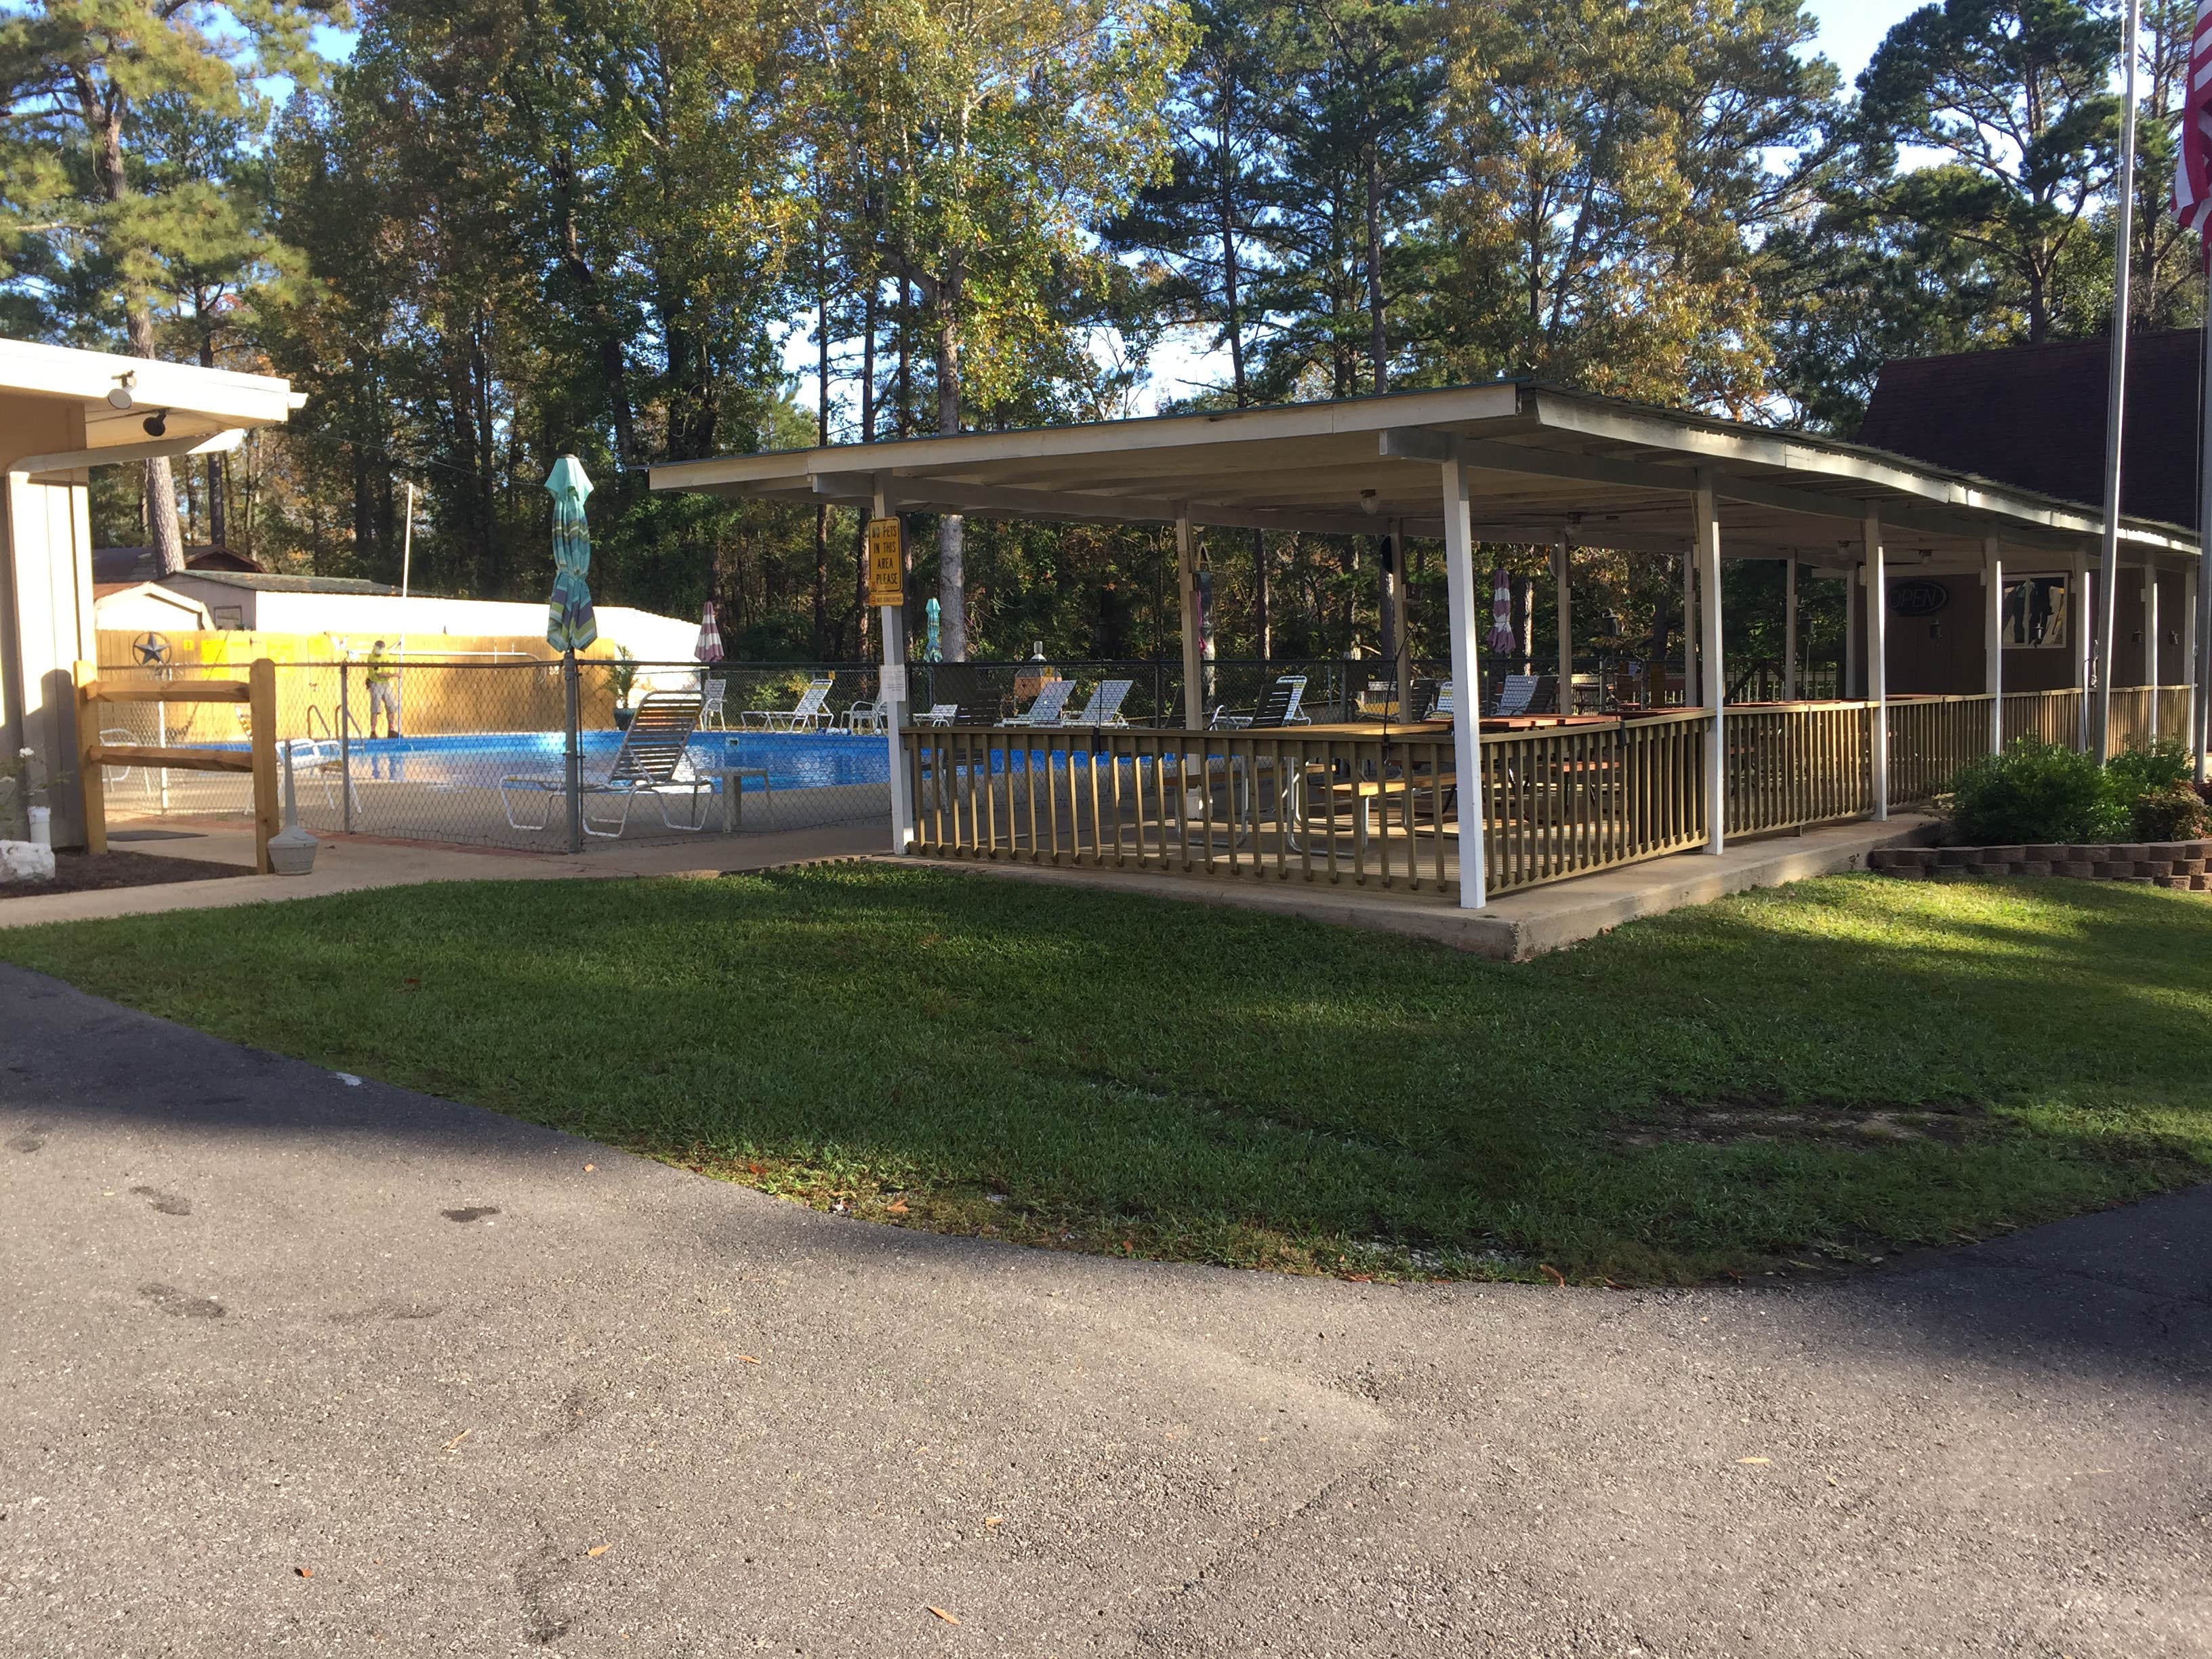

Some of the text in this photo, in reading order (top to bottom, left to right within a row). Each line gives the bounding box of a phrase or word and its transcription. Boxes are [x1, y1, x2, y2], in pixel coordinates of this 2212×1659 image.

[872, 525, 897, 538] NO PETS
[874, 541, 896, 554] IN THIS
[878, 557, 893, 569] AREA
[876, 573, 897, 585] PLEASE
[1888, 588, 1936, 608] OPEN
